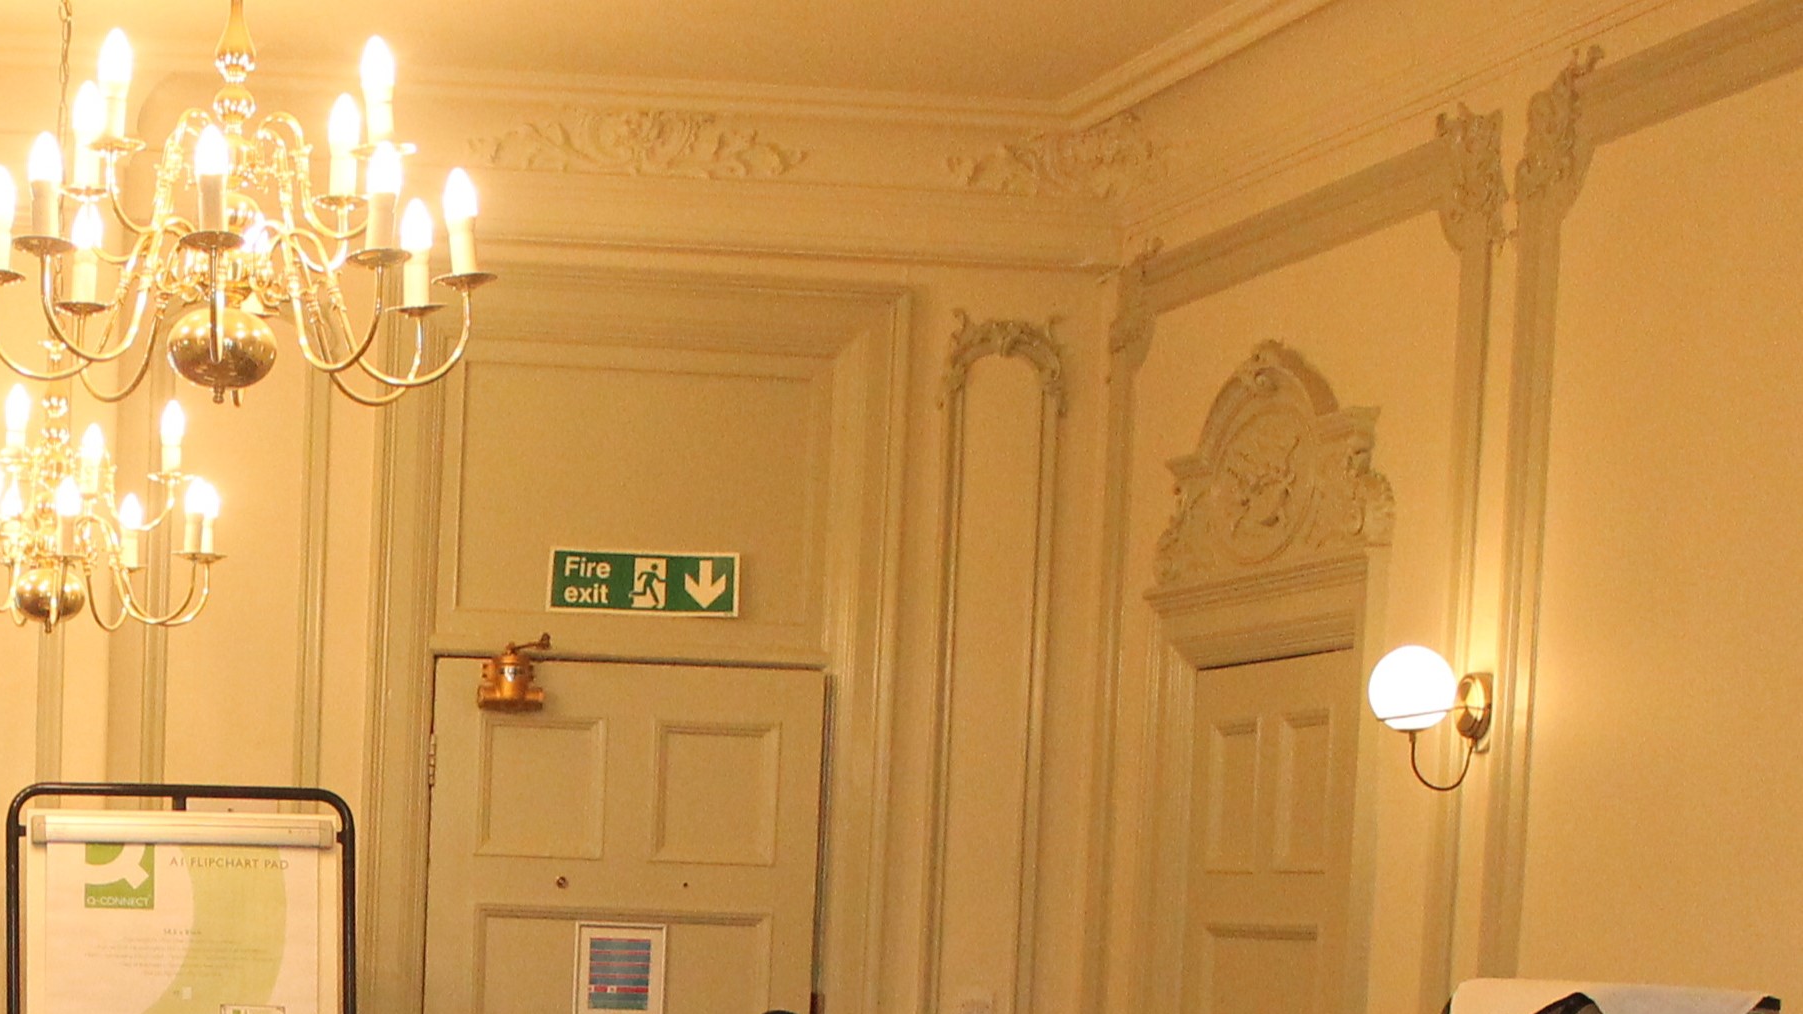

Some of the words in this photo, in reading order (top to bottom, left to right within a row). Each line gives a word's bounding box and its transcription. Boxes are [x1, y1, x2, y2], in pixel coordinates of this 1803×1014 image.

[564, 556, 611, 578] Fire
[563, 584, 609, 604] exit
[190, 858, 259, 869] FLIPCHART
[264, 859, 289, 870] PAD
[86, 895, 150, 907] Q-CONNECT
